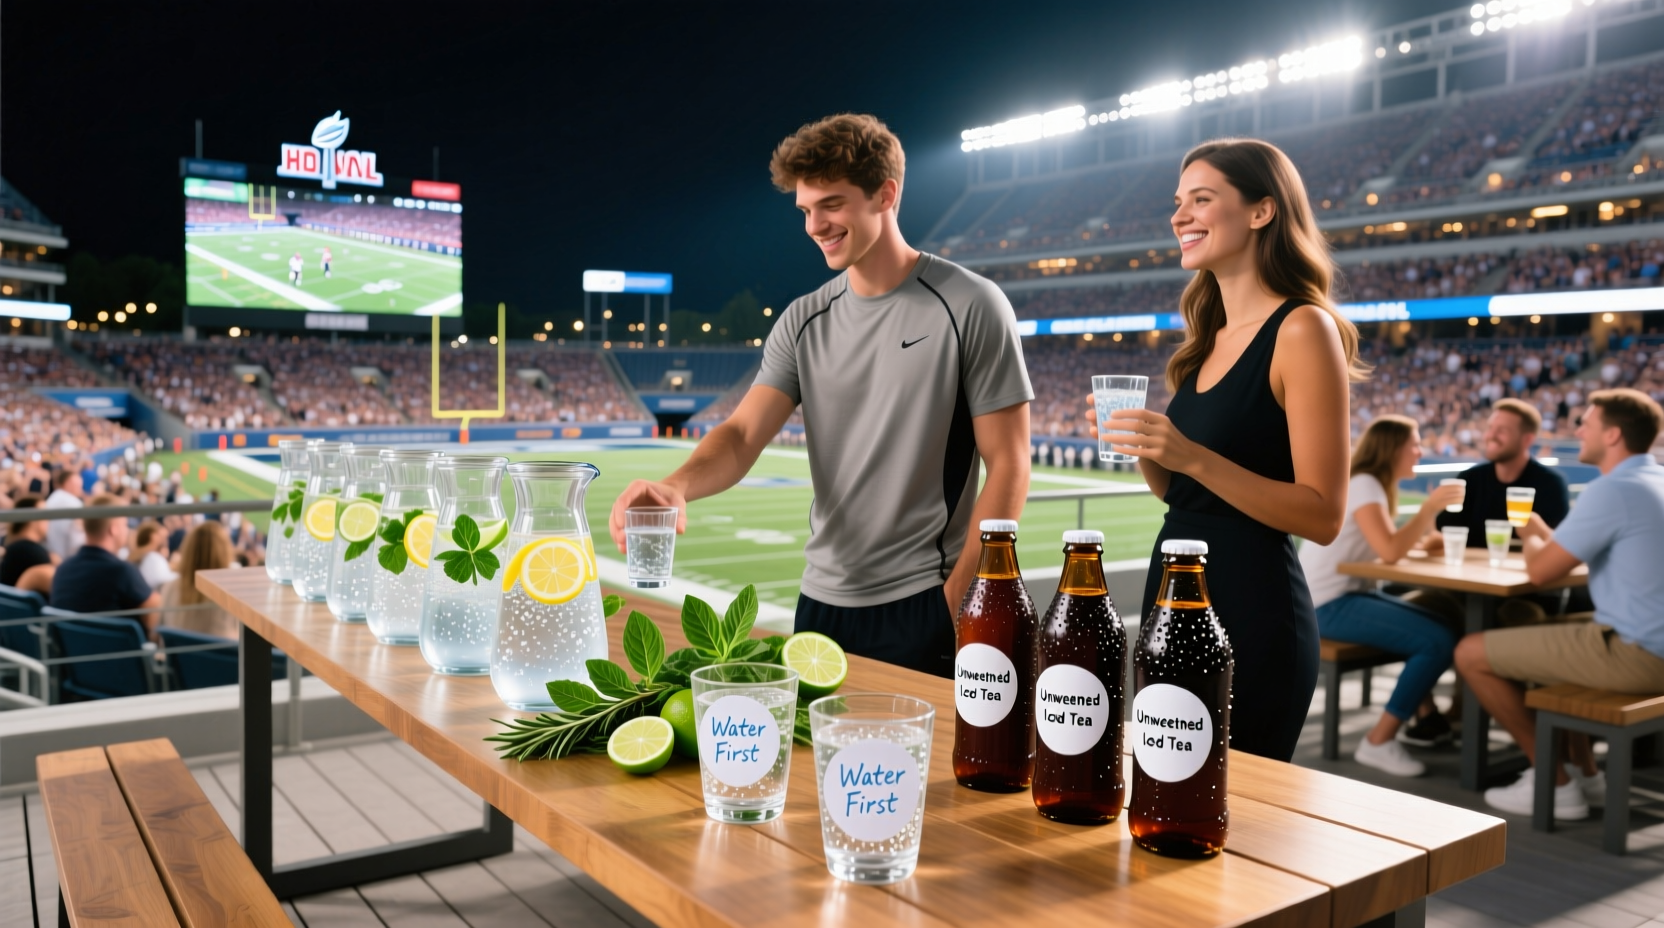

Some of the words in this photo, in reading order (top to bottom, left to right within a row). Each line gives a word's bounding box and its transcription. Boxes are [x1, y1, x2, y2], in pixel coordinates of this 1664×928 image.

[980, 687, 1001, 701] Tea
[712, 716, 766, 737] Water
[1069, 712, 1093, 727] Tea
[715, 741, 760, 764] First
[1167, 736, 1192, 752] Tea
[840, 762, 906, 788] Water
[846, 791, 899, 817] First
